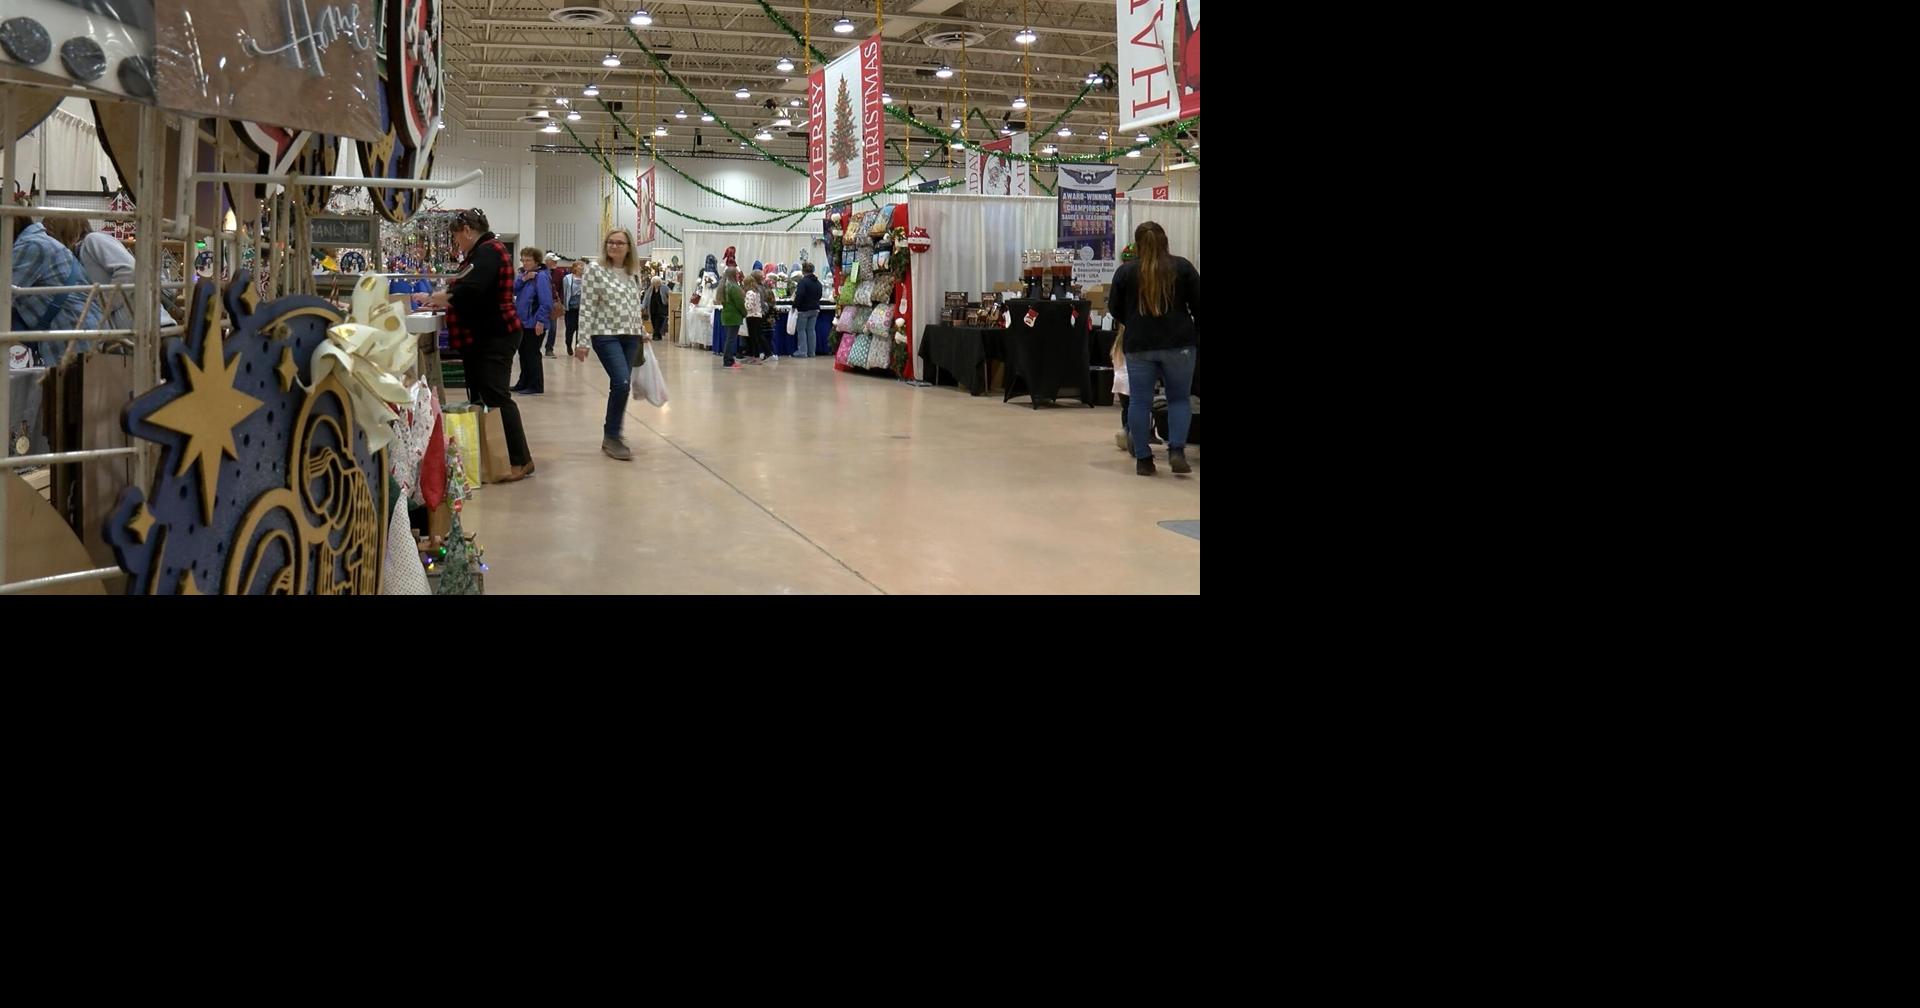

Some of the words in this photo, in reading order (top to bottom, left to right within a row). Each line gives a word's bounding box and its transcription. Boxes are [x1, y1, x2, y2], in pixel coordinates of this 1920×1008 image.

[241, 0, 369, 76] Home
[1130, 0, 1169, 118] HA
[812, 82, 824, 200] MERRY
[864, 41, 881, 186] CHRISTMAS
[1066, 204, 1110, 212] CHAMPIONSHIP
